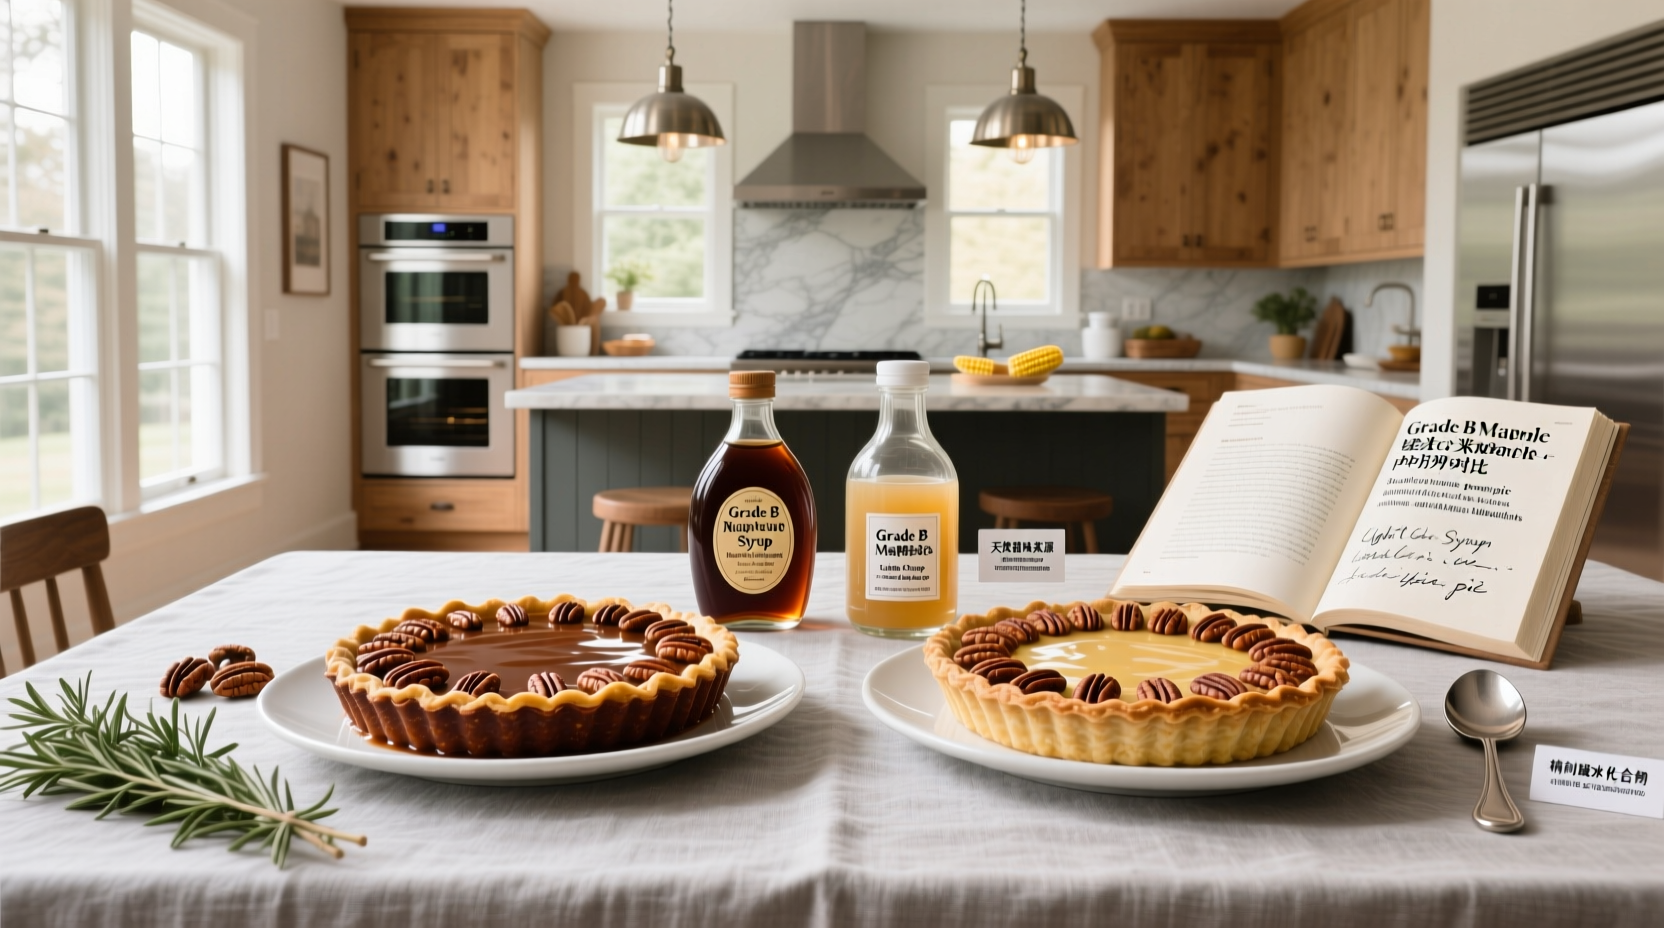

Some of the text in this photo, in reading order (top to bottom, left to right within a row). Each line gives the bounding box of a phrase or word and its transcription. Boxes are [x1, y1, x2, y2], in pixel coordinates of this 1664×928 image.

[1407, 419, 1460, 435] Grade
[1463, 420, 1476, 435] B
[728, 505, 780, 518] Grade B
[876, 528, 928, 541] Grade B
[737, 535, 773, 551] Syrup
